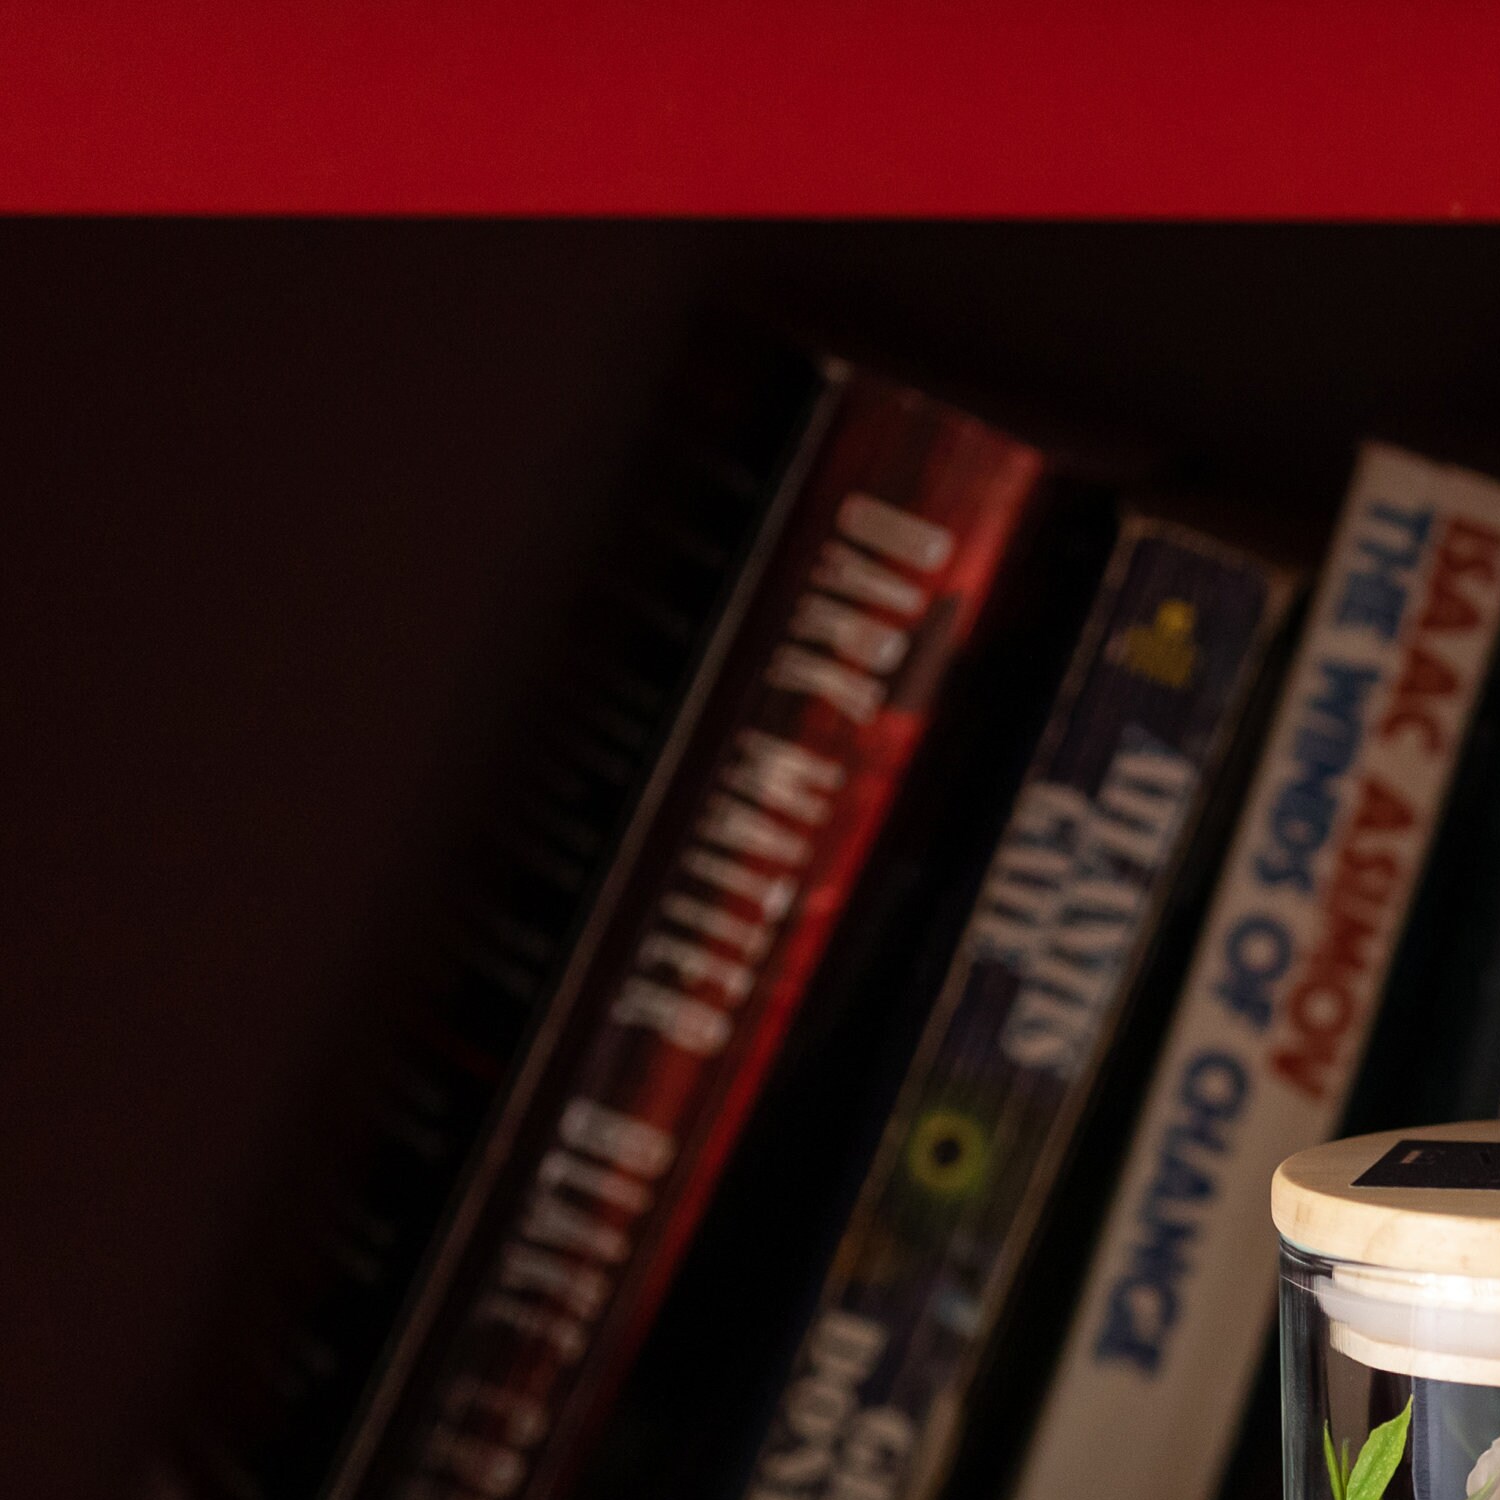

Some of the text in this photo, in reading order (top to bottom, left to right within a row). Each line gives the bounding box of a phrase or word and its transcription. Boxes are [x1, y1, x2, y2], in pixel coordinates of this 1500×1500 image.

[764, 490, 957, 727] DARK
[610, 726, 848, 1057] MATTER
[1095, 503, 1437, 1371] THE WINDS OF CHANGE
[1271, 774, 1415, 1098] ASIMOV
[472, 1096, 680, 1366] BLAKE
